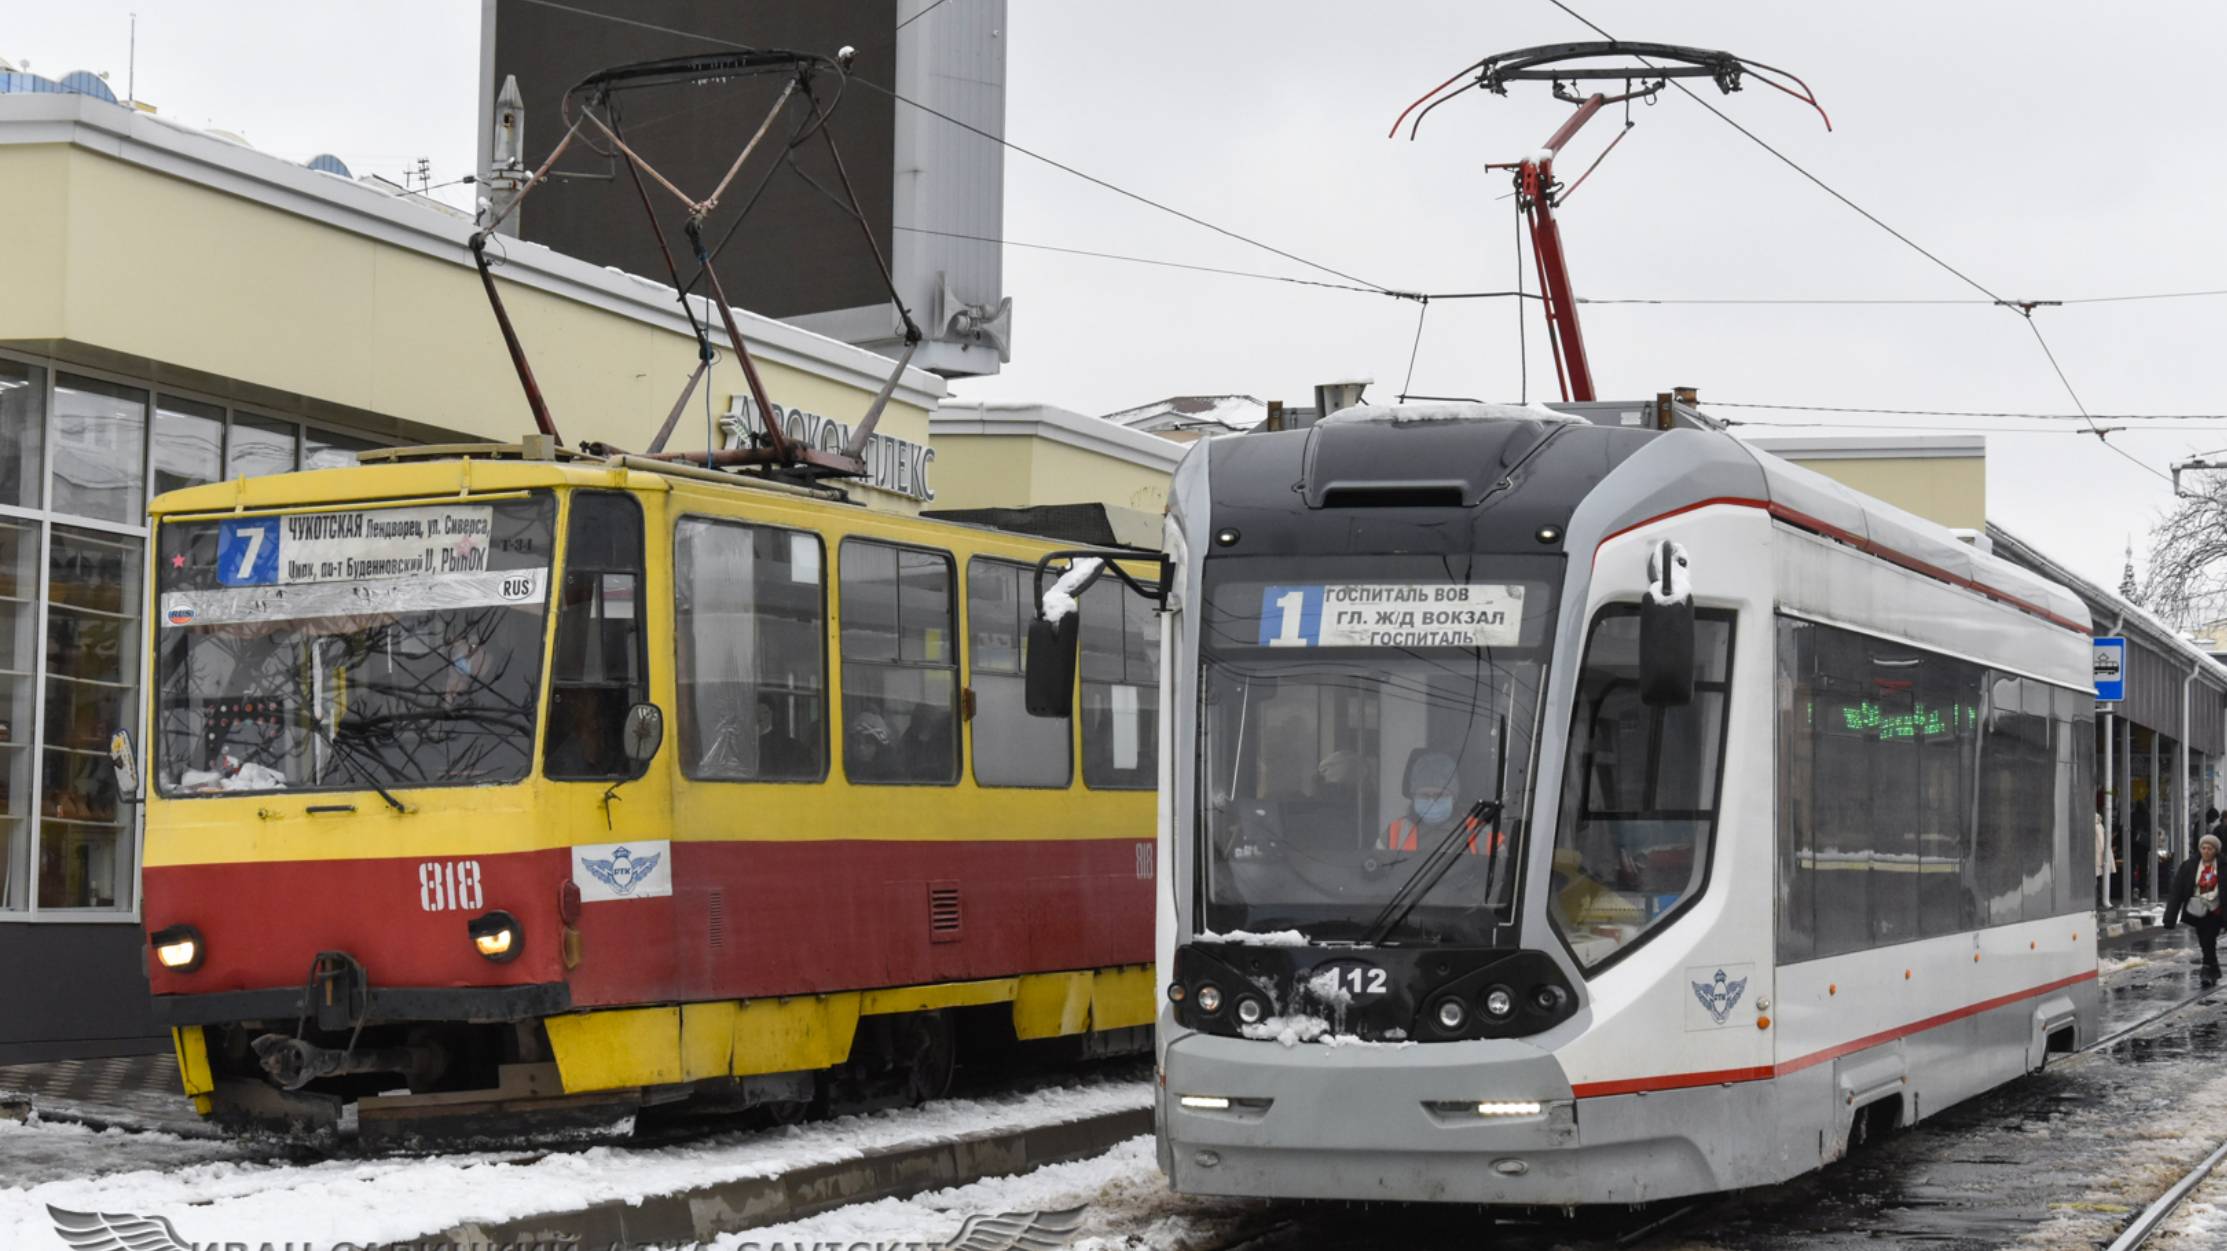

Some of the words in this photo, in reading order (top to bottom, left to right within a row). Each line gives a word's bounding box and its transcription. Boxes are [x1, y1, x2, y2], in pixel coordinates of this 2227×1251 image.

[288, 513, 364, 541] ЧУКОТСКАЯ
[235, 527, 265, 579] 7
[503, 579, 530, 597] RUS
[1325, 588, 1429, 603] ГОСПИТАЛЬ
[1434, 588, 1470, 602] ВОВ
[1268, 591, 1308, 647] 1
[1336, 610, 1368, 626] ГЛ.
[1375, 610, 1416, 628] Ж/Д
[1421, 610, 1505, 626] ВОКЗАЛ
[418, 860, 484, 912] 818
